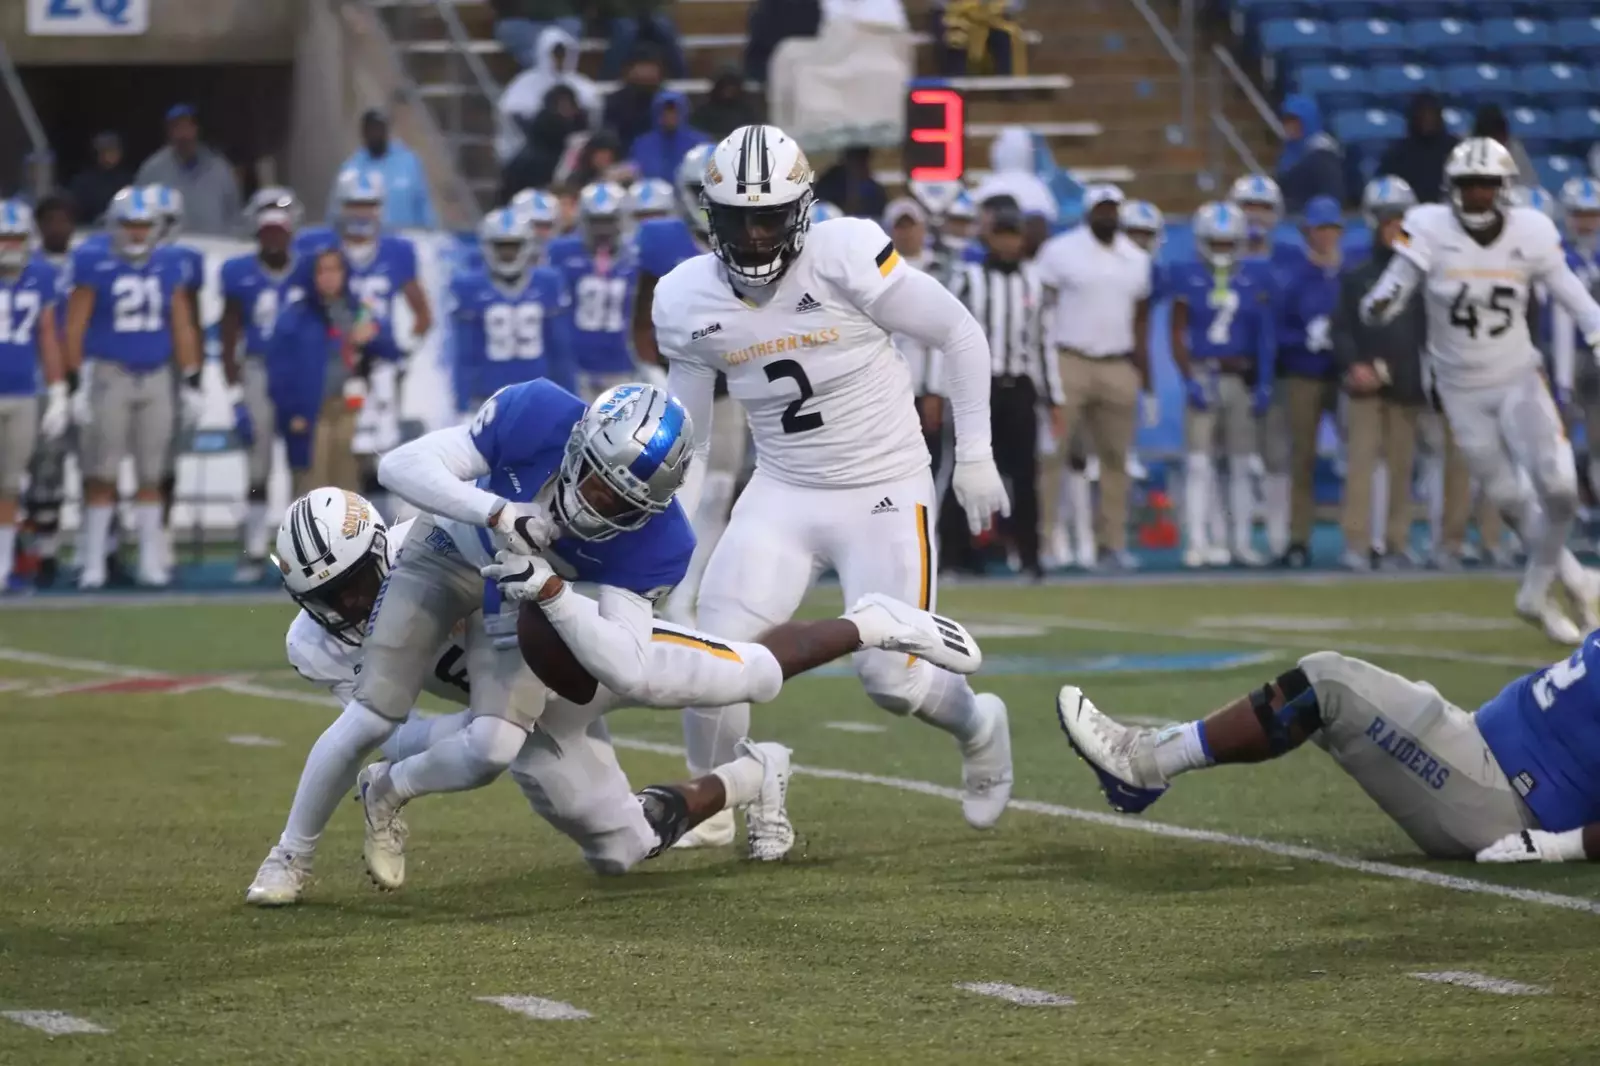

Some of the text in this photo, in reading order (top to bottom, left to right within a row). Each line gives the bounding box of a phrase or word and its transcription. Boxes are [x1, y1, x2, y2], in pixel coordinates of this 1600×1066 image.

[910, 89, 964, 182] 3
[111, 274, 163, 332] 21
[1449, 281, 1517, 340] 45
[721, 327, 840, 366] SOUTHERN MISS
[763, 358, 825, 434] 2
[1364, 716, 1450, 790] RAIDERS
